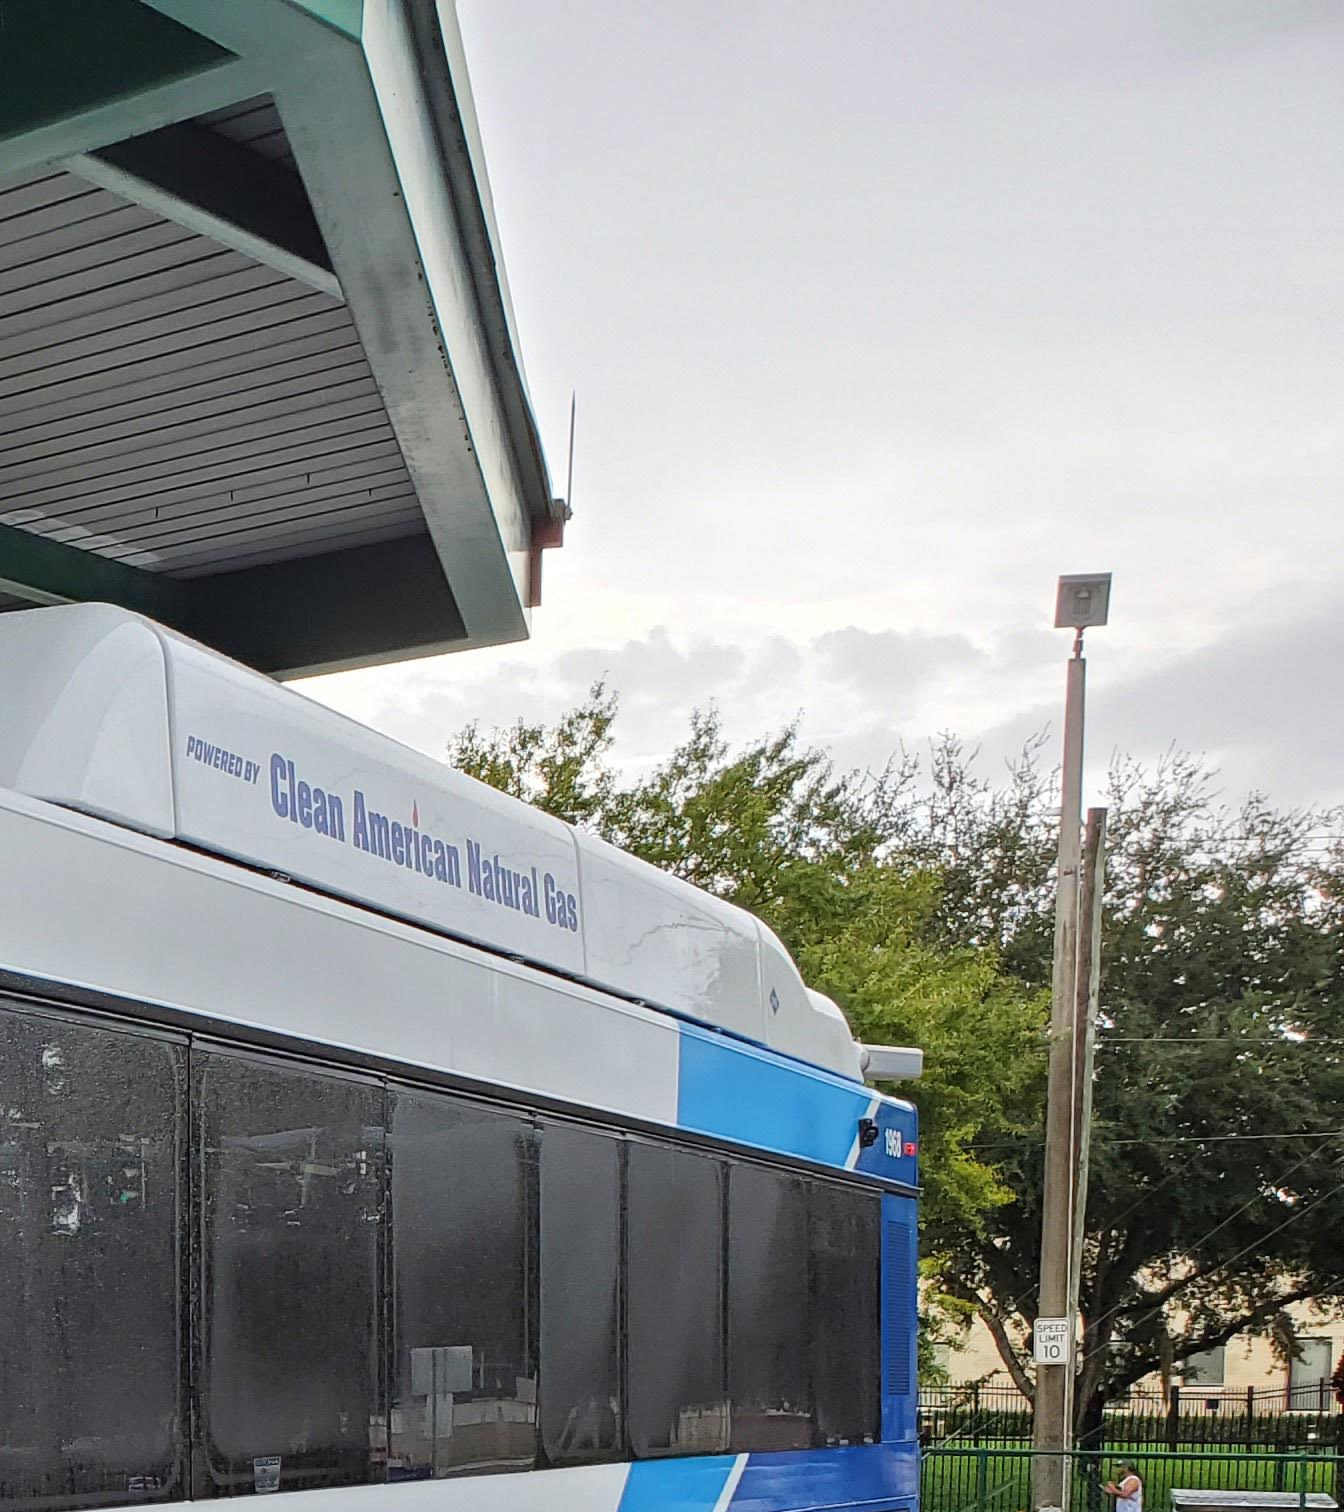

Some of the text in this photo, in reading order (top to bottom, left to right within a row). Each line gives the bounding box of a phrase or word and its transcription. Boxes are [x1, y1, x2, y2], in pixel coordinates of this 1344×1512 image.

[186, 735, 261, 786] POWERED BY
[269, 752, 578, 933] Clean American Natural Gas
[1037, 1323, 1068, 1333] SPEED
[1039, 1334, 1064, 1343] LIMIT
[1043, 1344, 1060, 1358] 10
